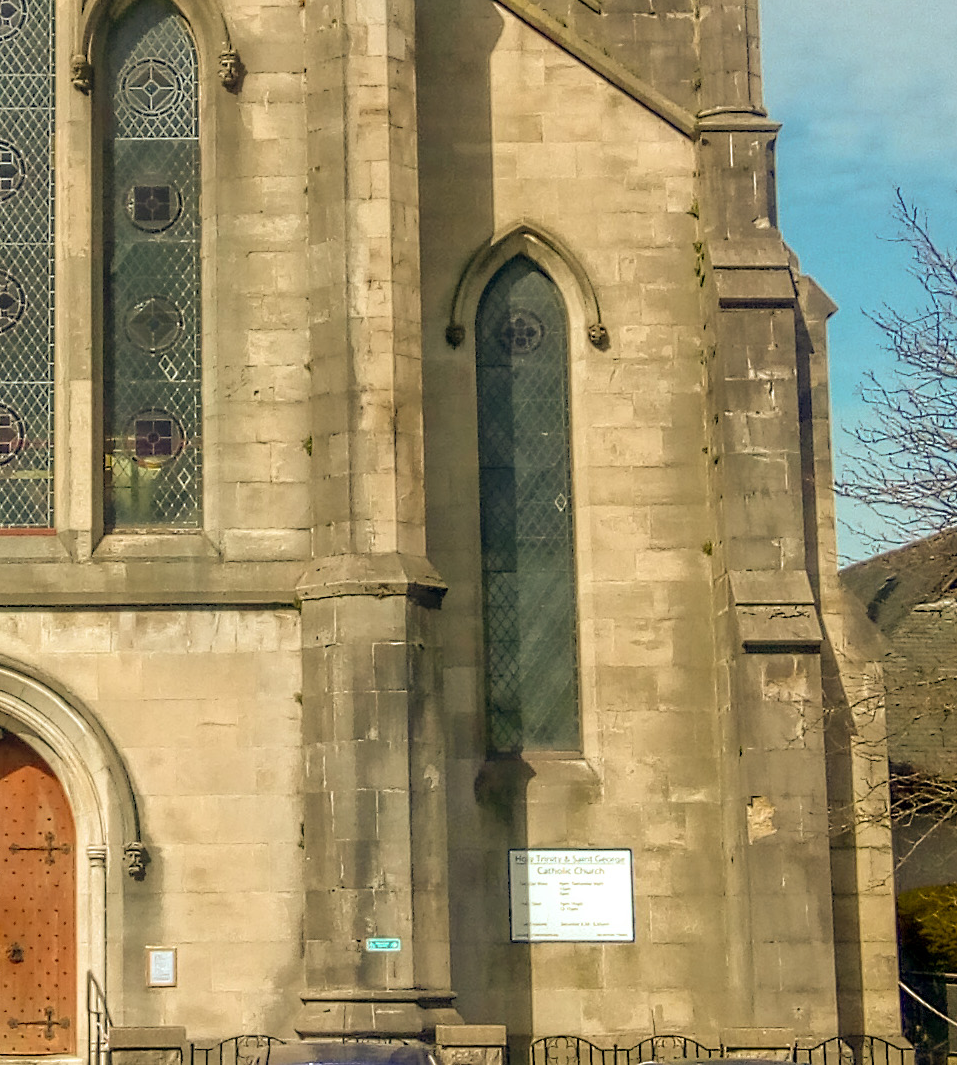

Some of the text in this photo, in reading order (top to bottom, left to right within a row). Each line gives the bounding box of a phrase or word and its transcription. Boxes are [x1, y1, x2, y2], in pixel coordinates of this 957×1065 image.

[515, 855, 626, 864] Hoy Trinity & Saint George
[537, 866, 605, 875] Catholic Church
